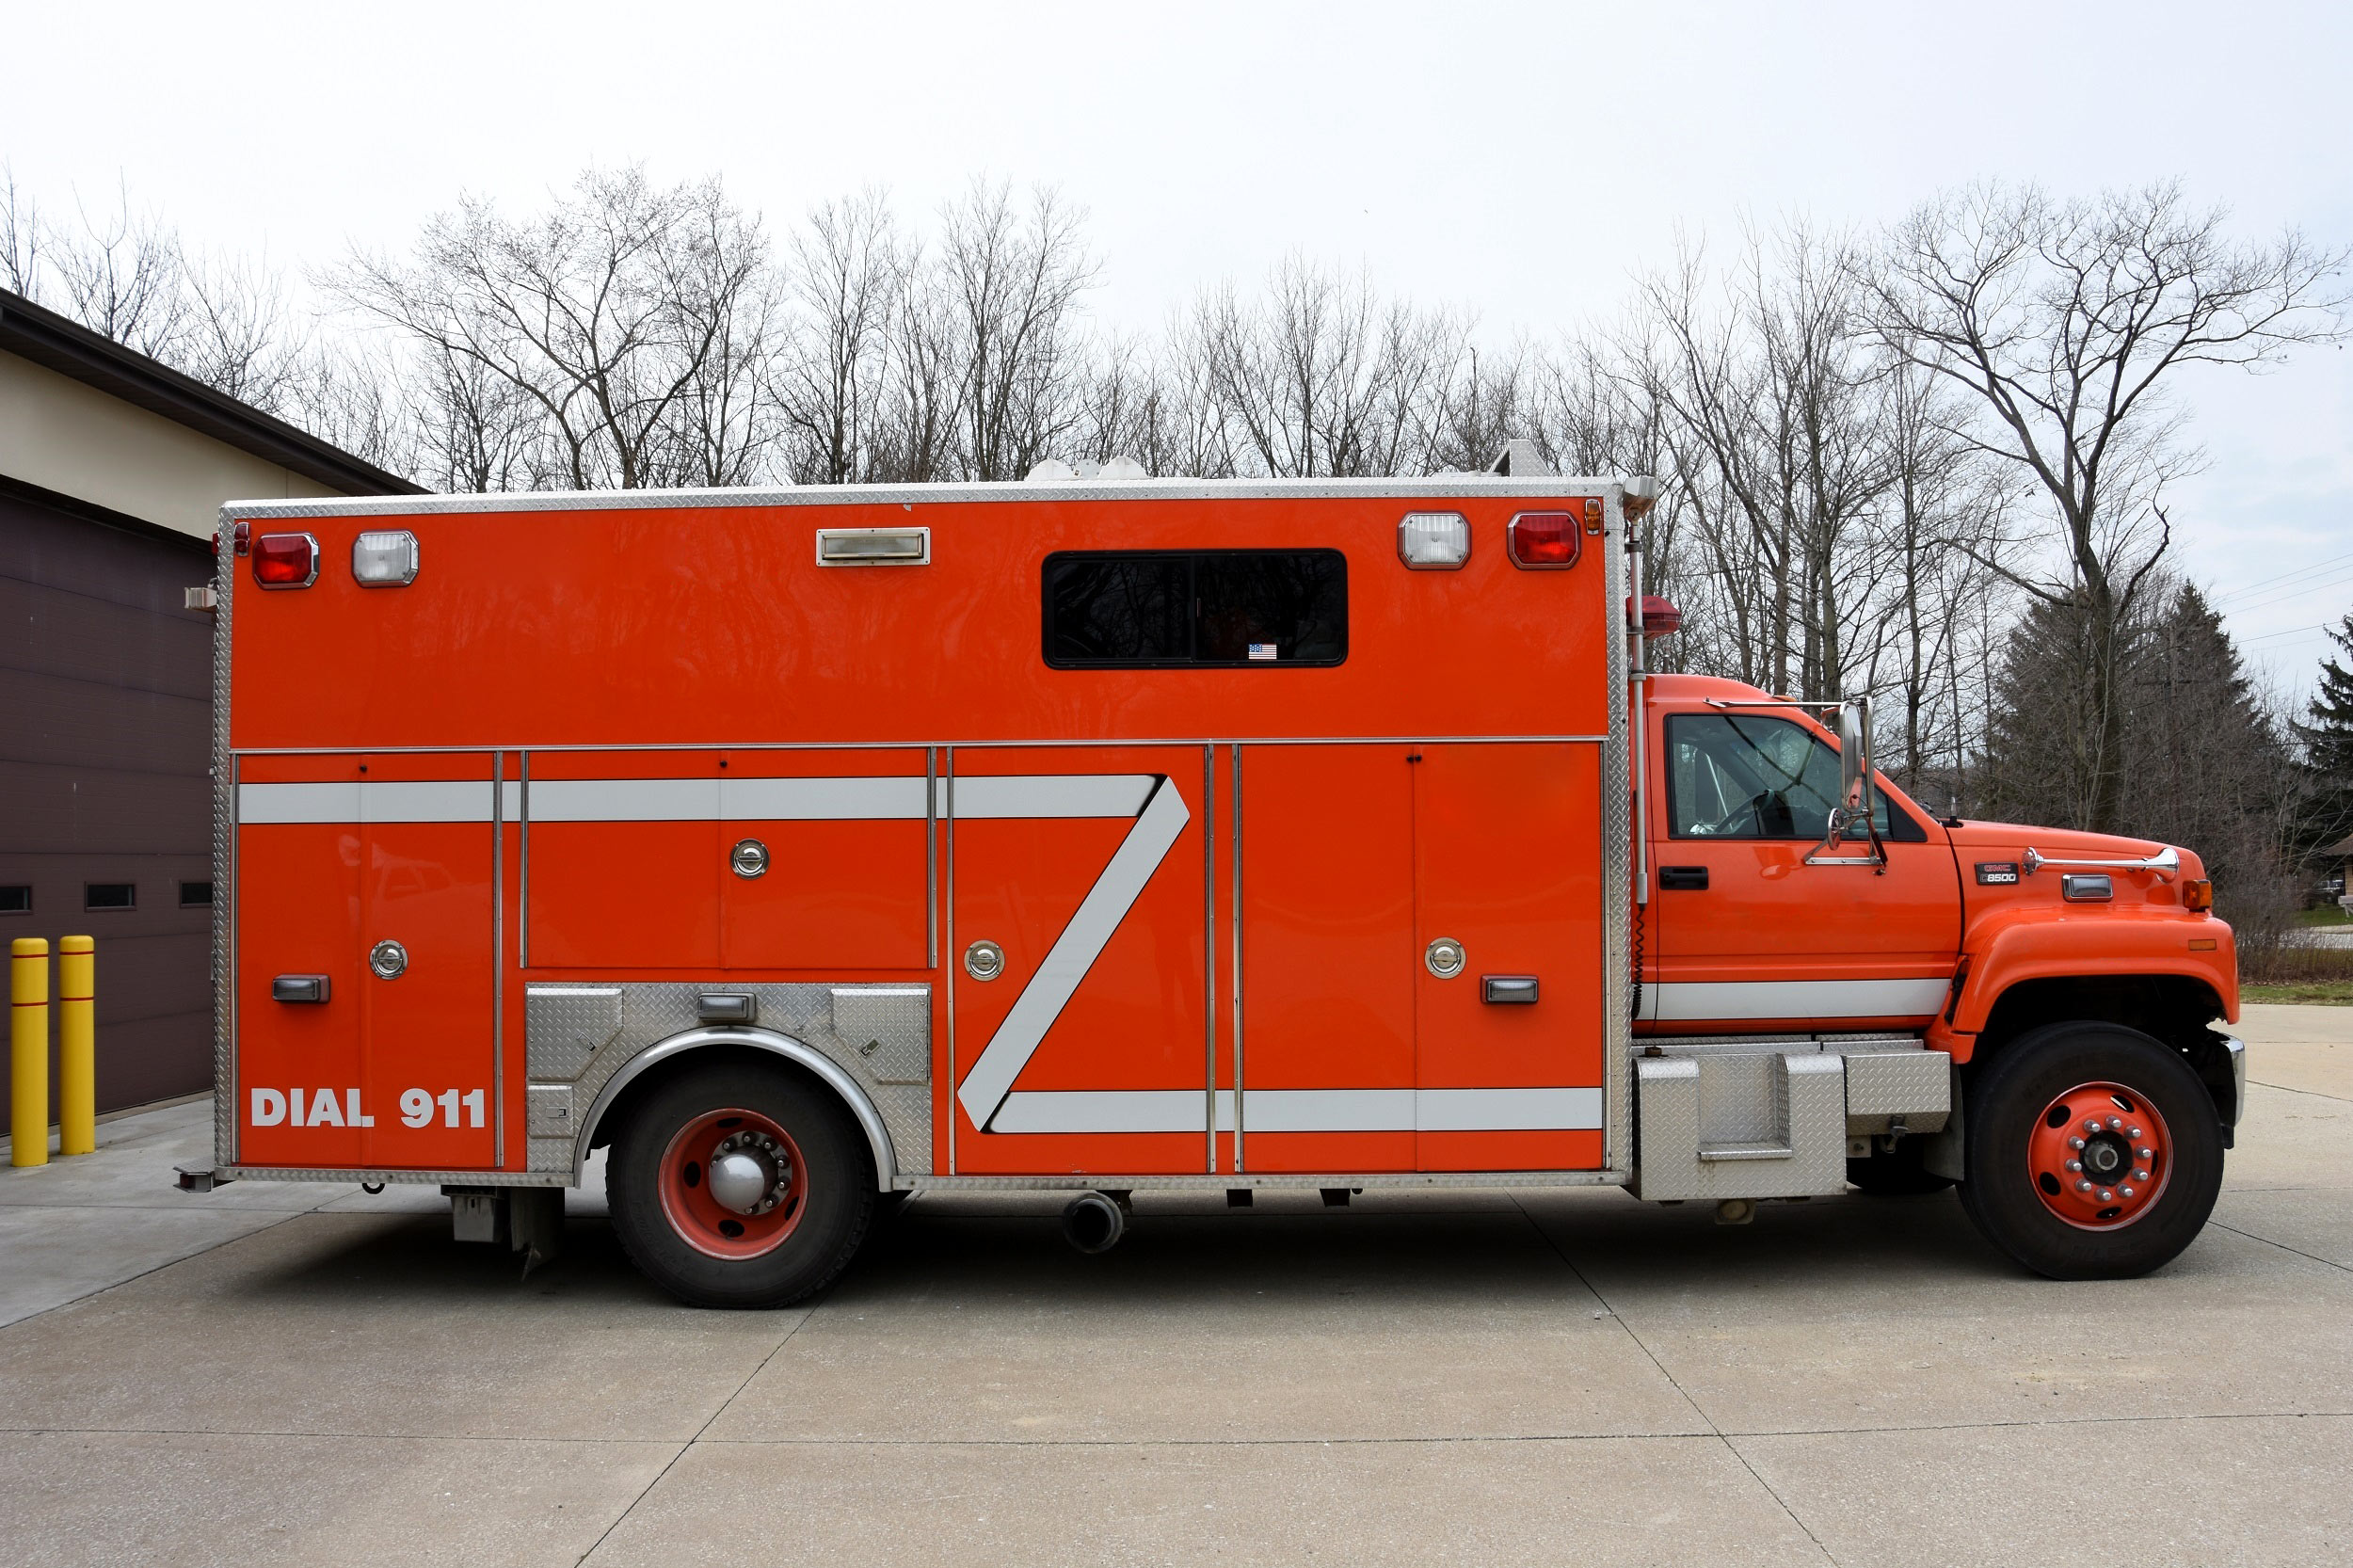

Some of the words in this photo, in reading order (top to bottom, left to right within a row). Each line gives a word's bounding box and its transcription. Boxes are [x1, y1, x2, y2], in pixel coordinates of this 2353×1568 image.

[1984, 864, 2011, 872] GMC
[250, 1087, 375, 1128] DIAL
[399, 1087, 485, 1128] 911
